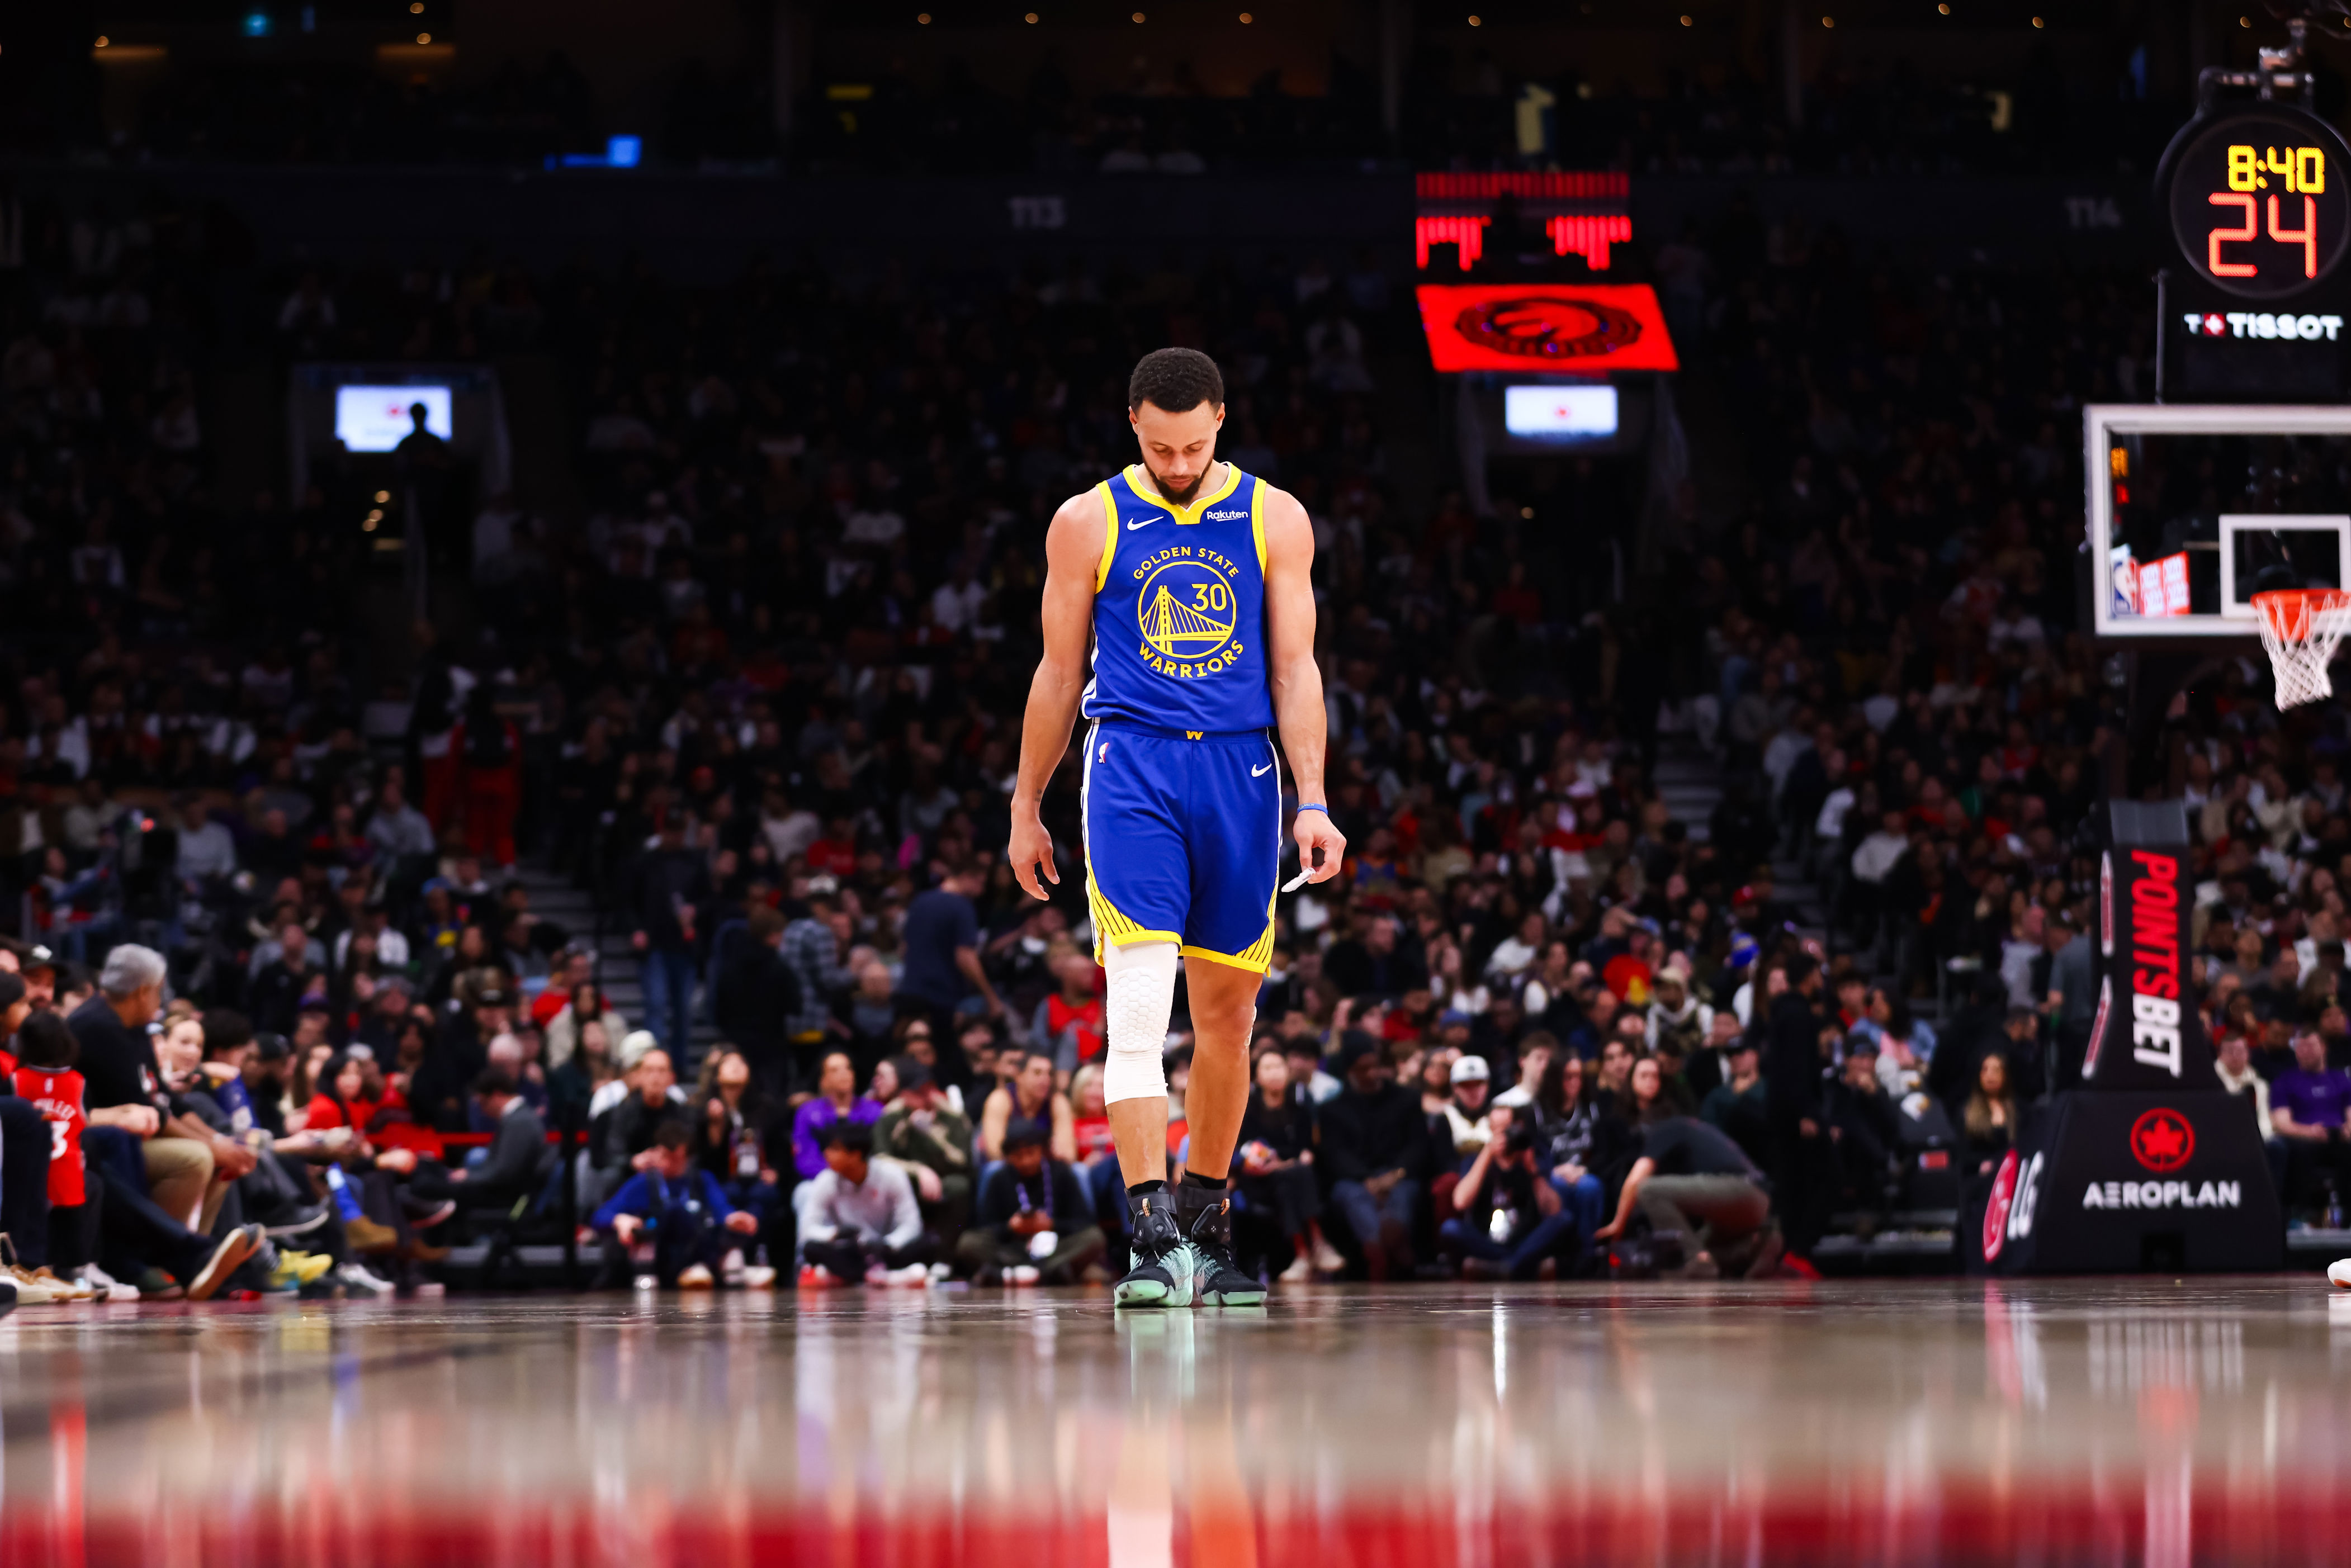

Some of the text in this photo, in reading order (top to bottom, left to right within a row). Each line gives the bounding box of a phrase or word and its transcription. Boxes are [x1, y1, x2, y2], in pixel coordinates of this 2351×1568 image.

[2228, 145, 2325, 193] 8:40
[1005, 196, 1066, 230] 113
[2208, 193, 2316, 279] 24
[2226, 312, 2343, 340] TISSOT
[1207, 510, 1248, 521] Rakuten
[1133, 546, 1240, 580] GOLDEN STATE
[1191, 583, 1227, 612] 30
[1139, 639, 1244, 678] WARRIORS
[2131, 849, 2182, 1079] POINTSBET
[2082, 1180, 2240, 1209] AEROPLAN
